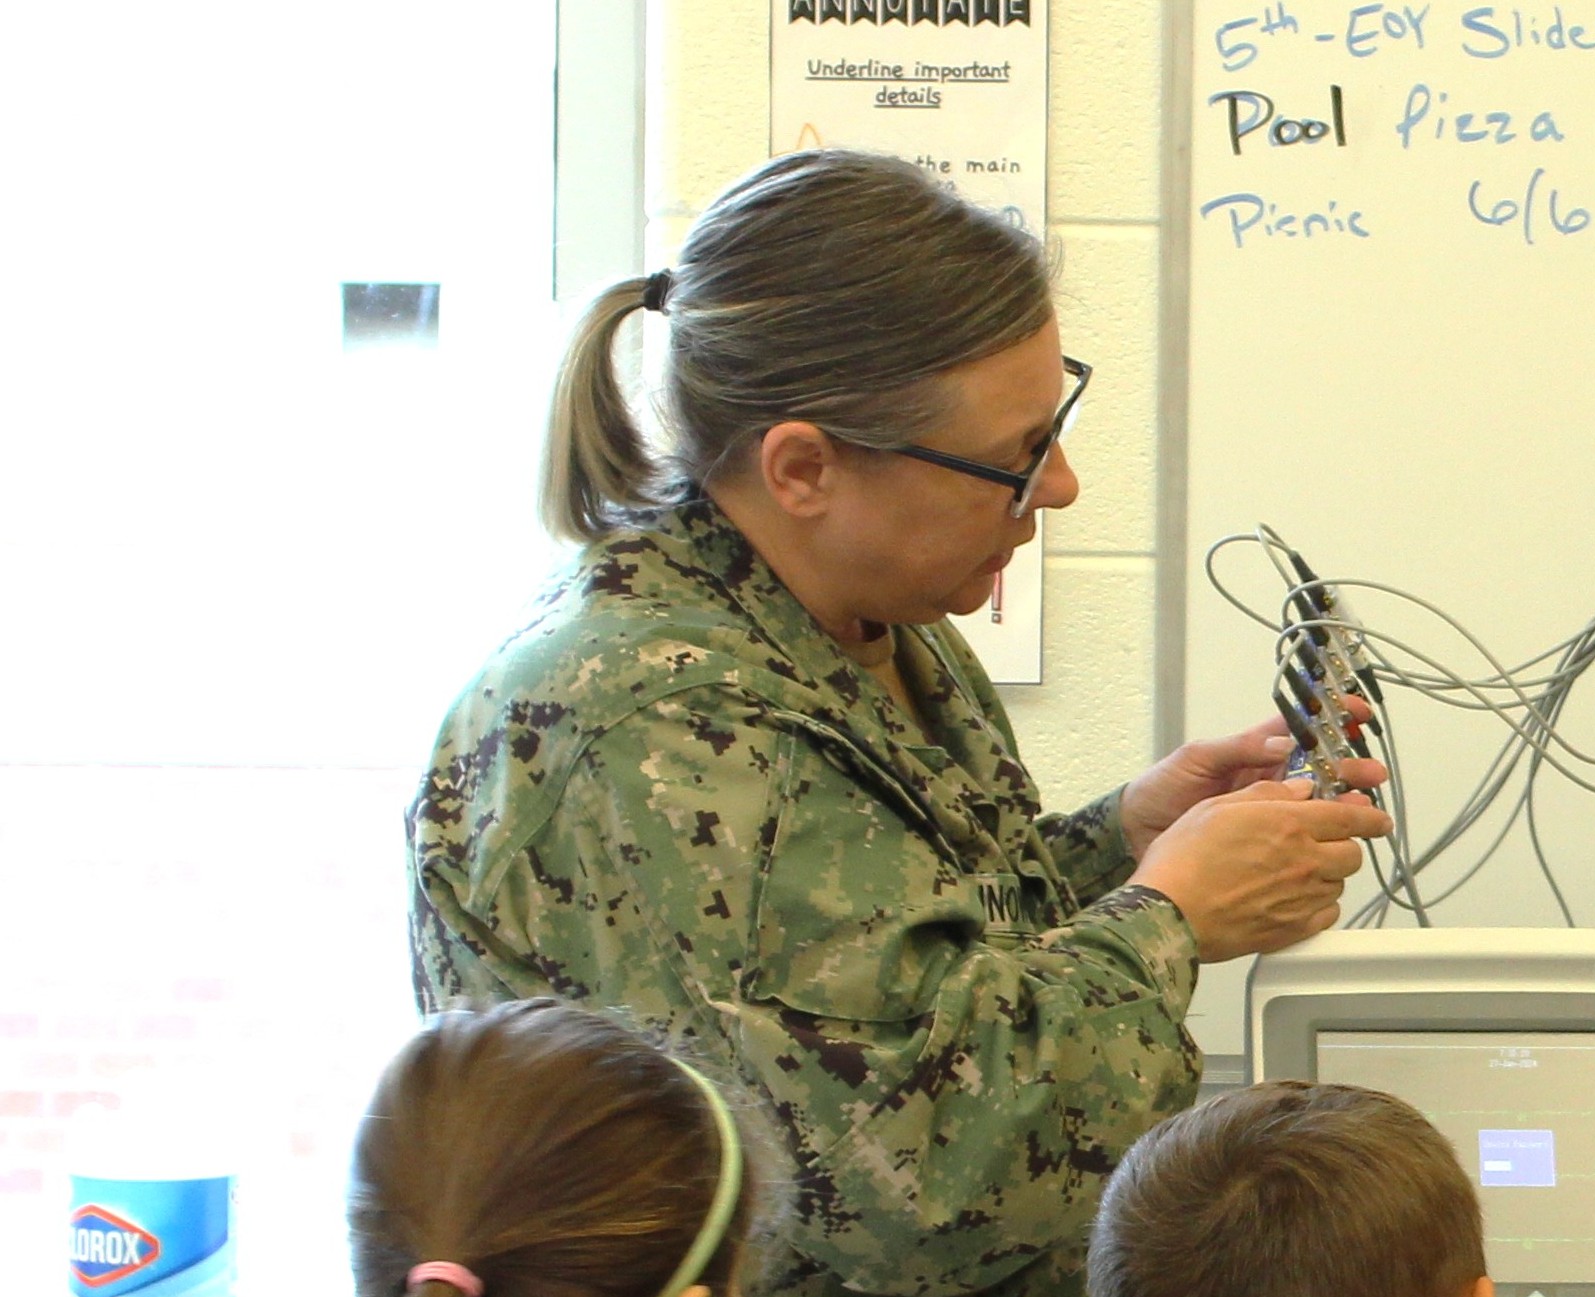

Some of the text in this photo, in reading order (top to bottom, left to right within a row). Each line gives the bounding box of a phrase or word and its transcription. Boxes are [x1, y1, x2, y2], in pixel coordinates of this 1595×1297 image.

[807, 59, 1011, 83] Underline important
[875, 86, 942, 106] details
[1207, 84, 1348, 156] Pool
[1396, 83, 1565, 150] Pizza
[965, 157, 1021, 174] main
[1199, 167, 1592, 249] Picnic 6/6
